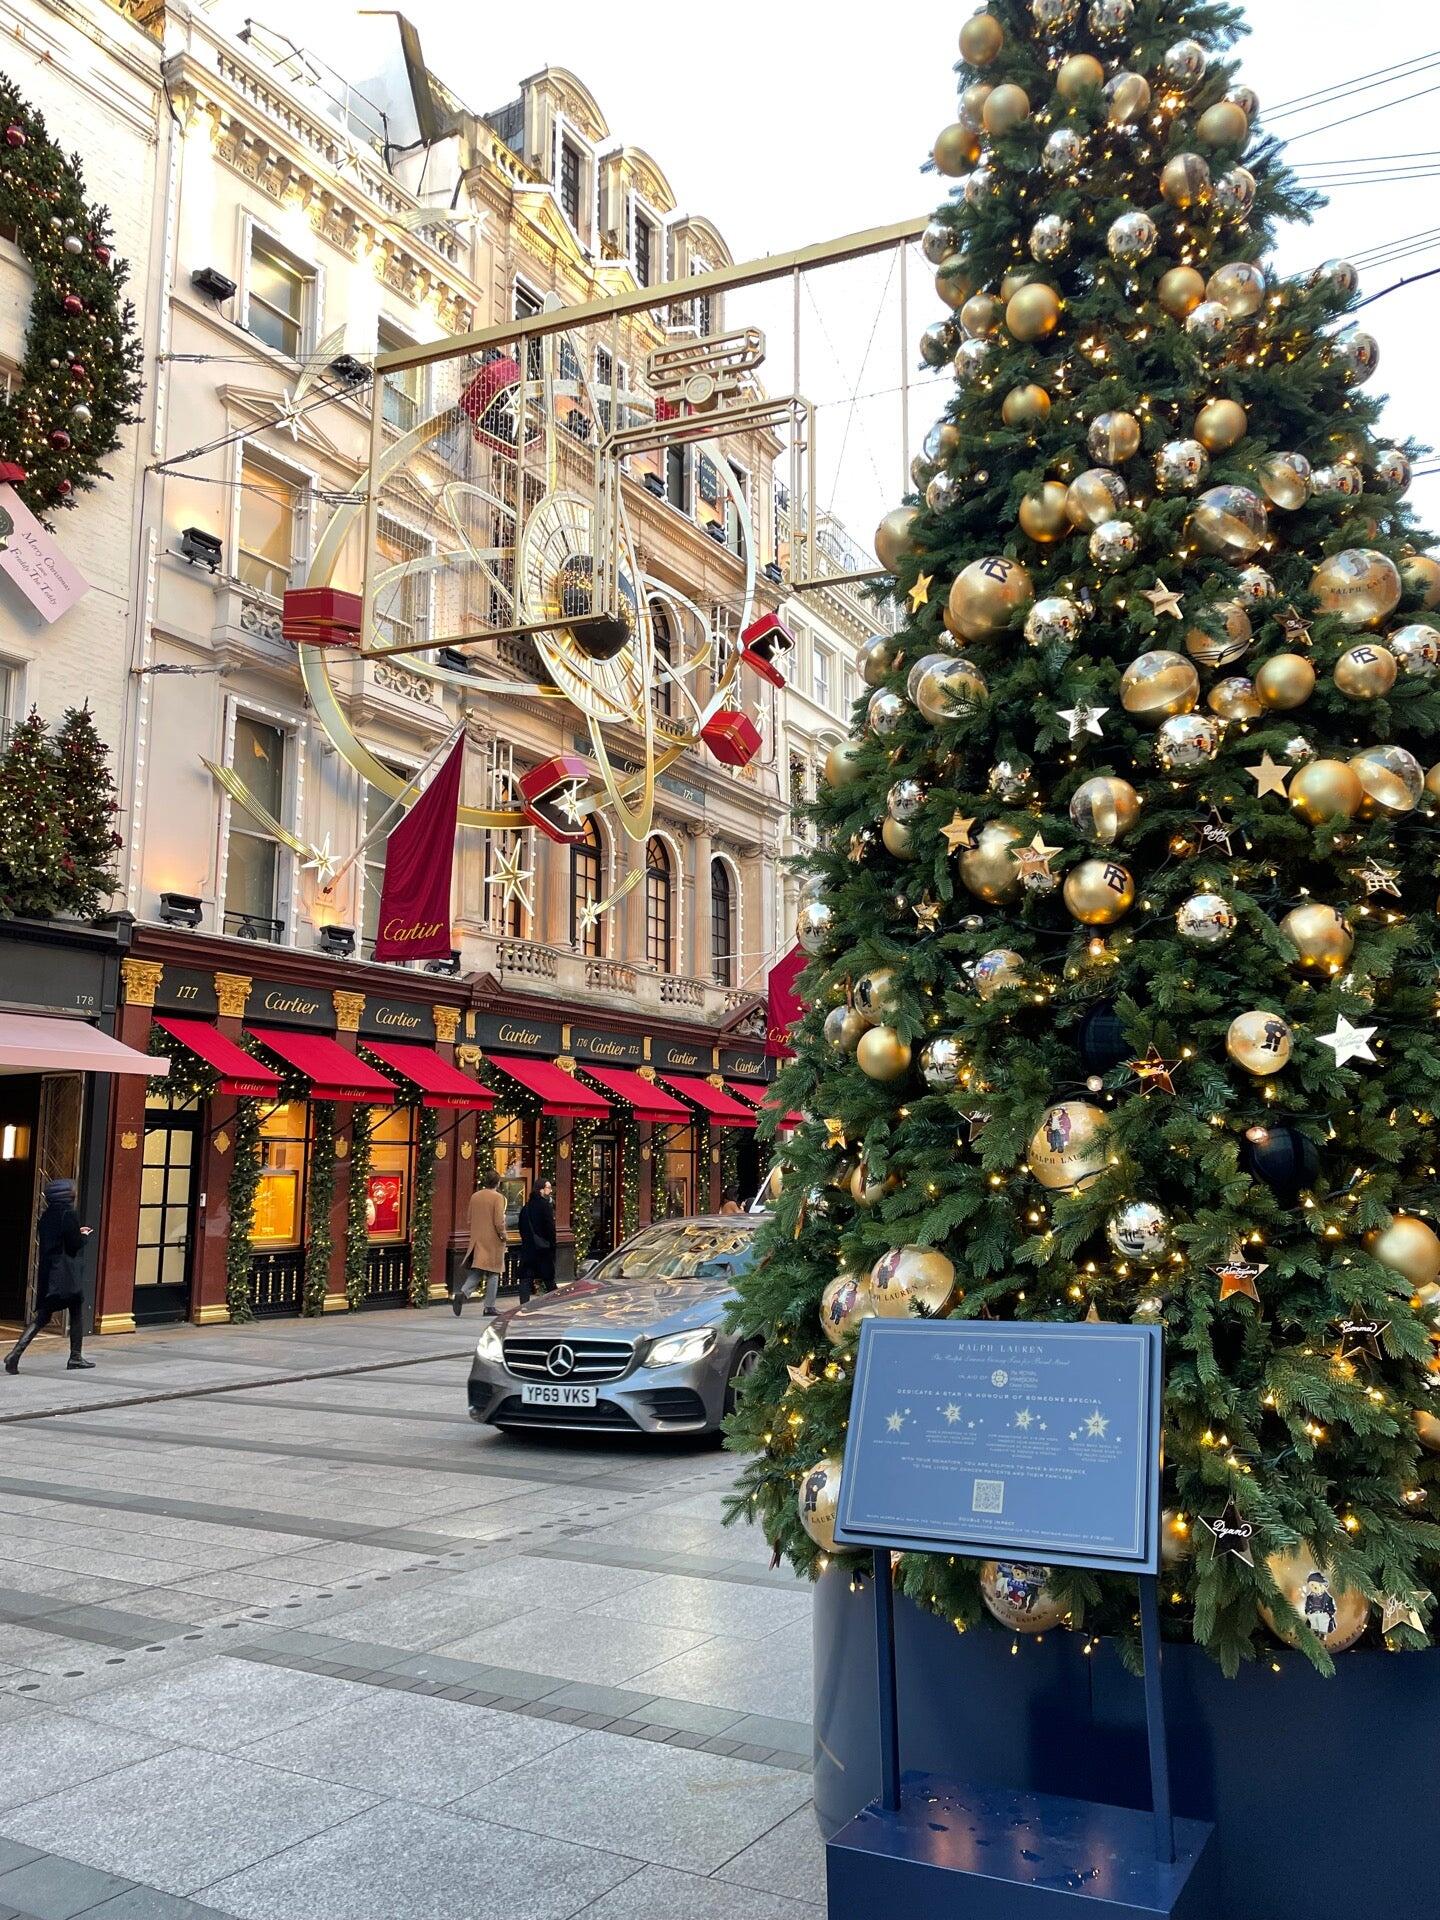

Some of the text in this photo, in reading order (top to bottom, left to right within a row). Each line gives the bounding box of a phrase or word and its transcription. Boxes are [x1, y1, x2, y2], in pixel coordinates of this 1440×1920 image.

[22, 532, 70, 591] Merry Christmas
[10, 548, 57, 605] Freddy The Teddy
[682, 789, 694, 800] 175
[383, 918, 444, 942] Cartier
[75, 995, 94, 1006] 178
[176, 985, 199, 999] 177
[264, 991, 319, 1015] Cartier
[375, 1007, 422, 1028] Cartier
[498, 1023, 542, 1045] Cartier
[576, 1036, 640, 1056] 176 Cartier 175
[667, 1048, 698, 1065] Cartier
[735, 1057, 762, 1074] Cartier
[234, 1080, 265, 1092] Cartier
[339, 1086, 368, 1098] Cartier
[447, 1096, 470, 1105] Cartier
[1031, 1151, 1081, 1164] RALPH LAU
[884, 1284, 918, 1302] LAUREN
[958, 1343, 1044, 1354] RALPH LAUREN
[527, 1386, 590, 1403] YP69 VKS
[897, 1388, 932, 1396] DEDICATE
[1025, 1395, 1065, 1403] SOMEONE
[1068, 1397, 1102, 1405] SPECIAL
[811, 1512, 836, 1524] LAURE
